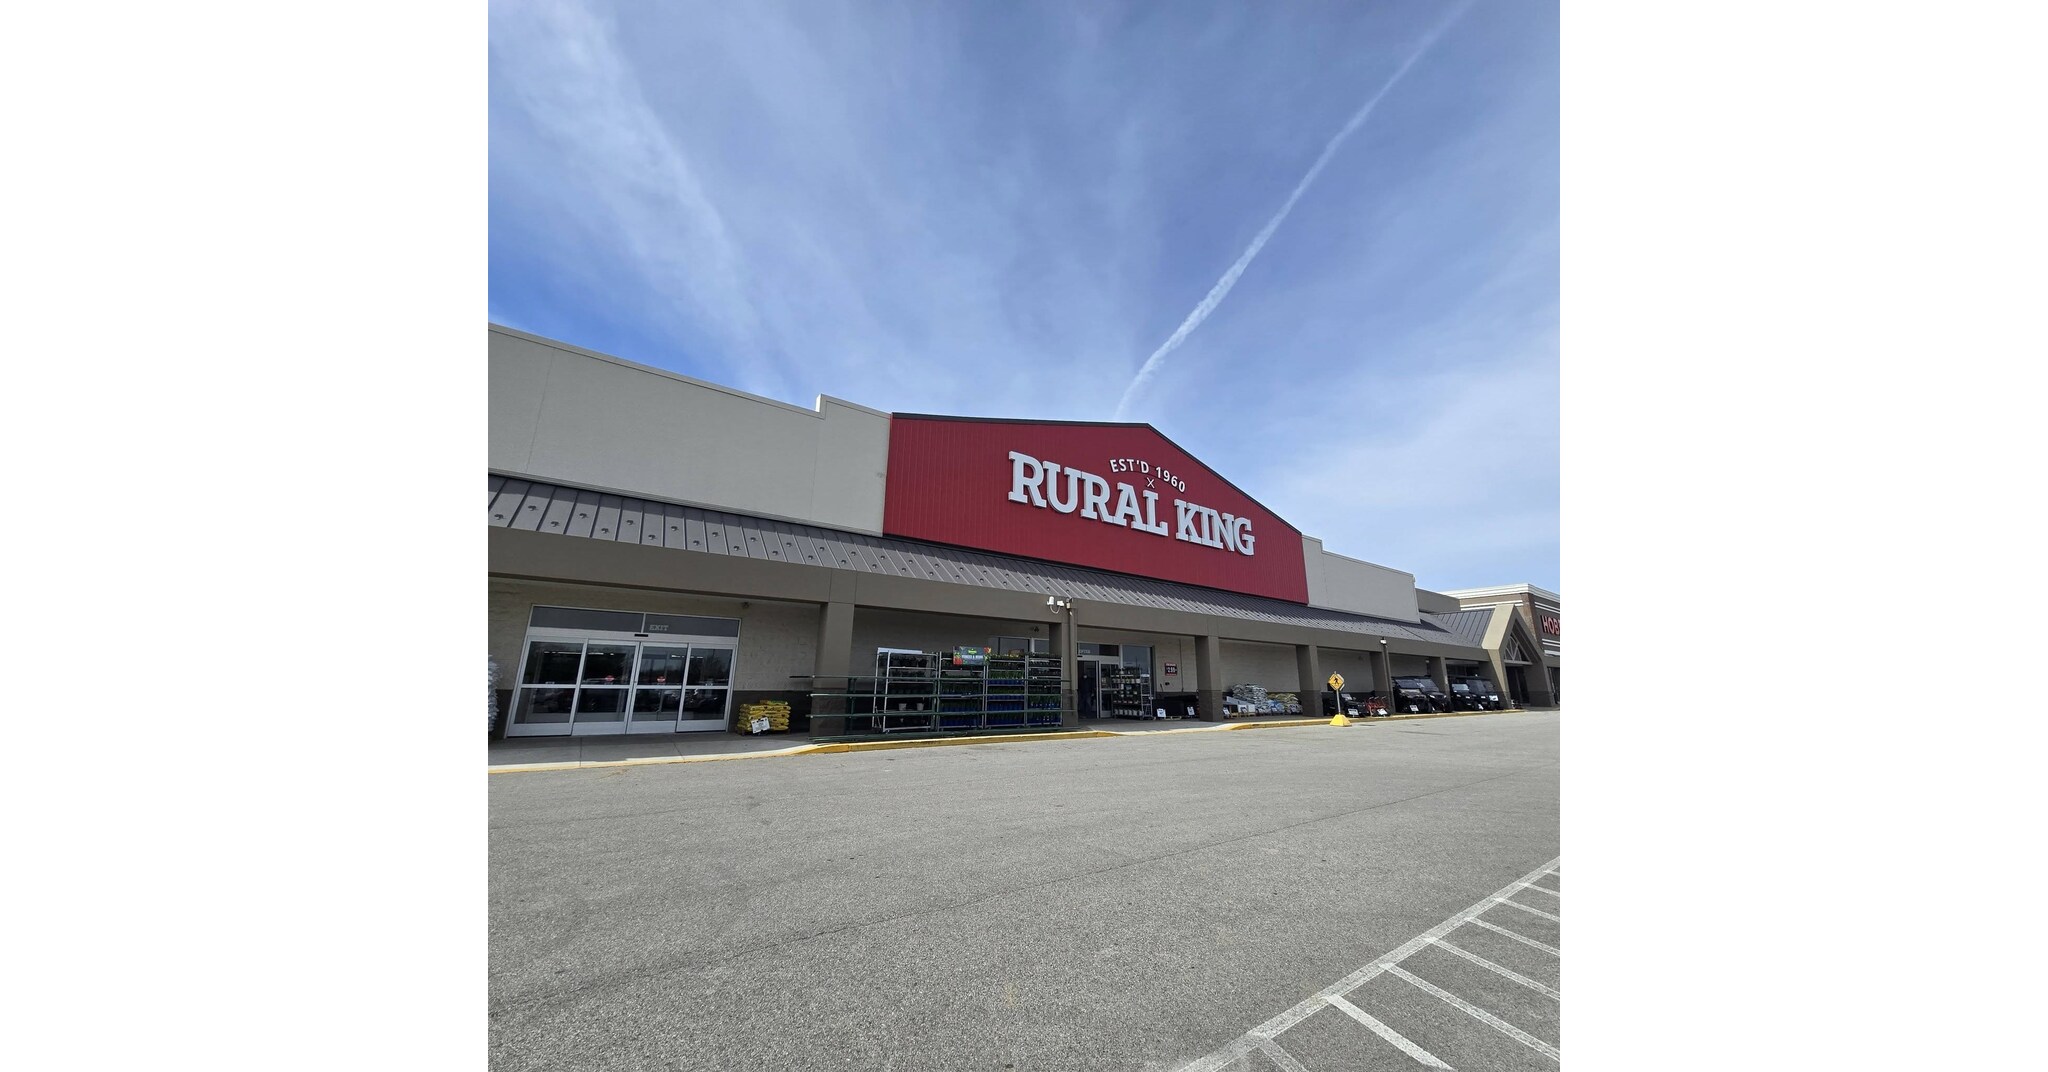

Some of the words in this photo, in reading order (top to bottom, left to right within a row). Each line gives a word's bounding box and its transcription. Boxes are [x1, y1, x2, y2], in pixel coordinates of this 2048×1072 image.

[1109, 458, 1149, 474] EST'D
[1155, 466, 1186, 493] 1960
[1008, 450, 1168, 537] RURAL
[1174, 498, 1255, 556] KING
[649, 624, 669, 632] EXIT
[1541, 615, 1560, 635] HOB
